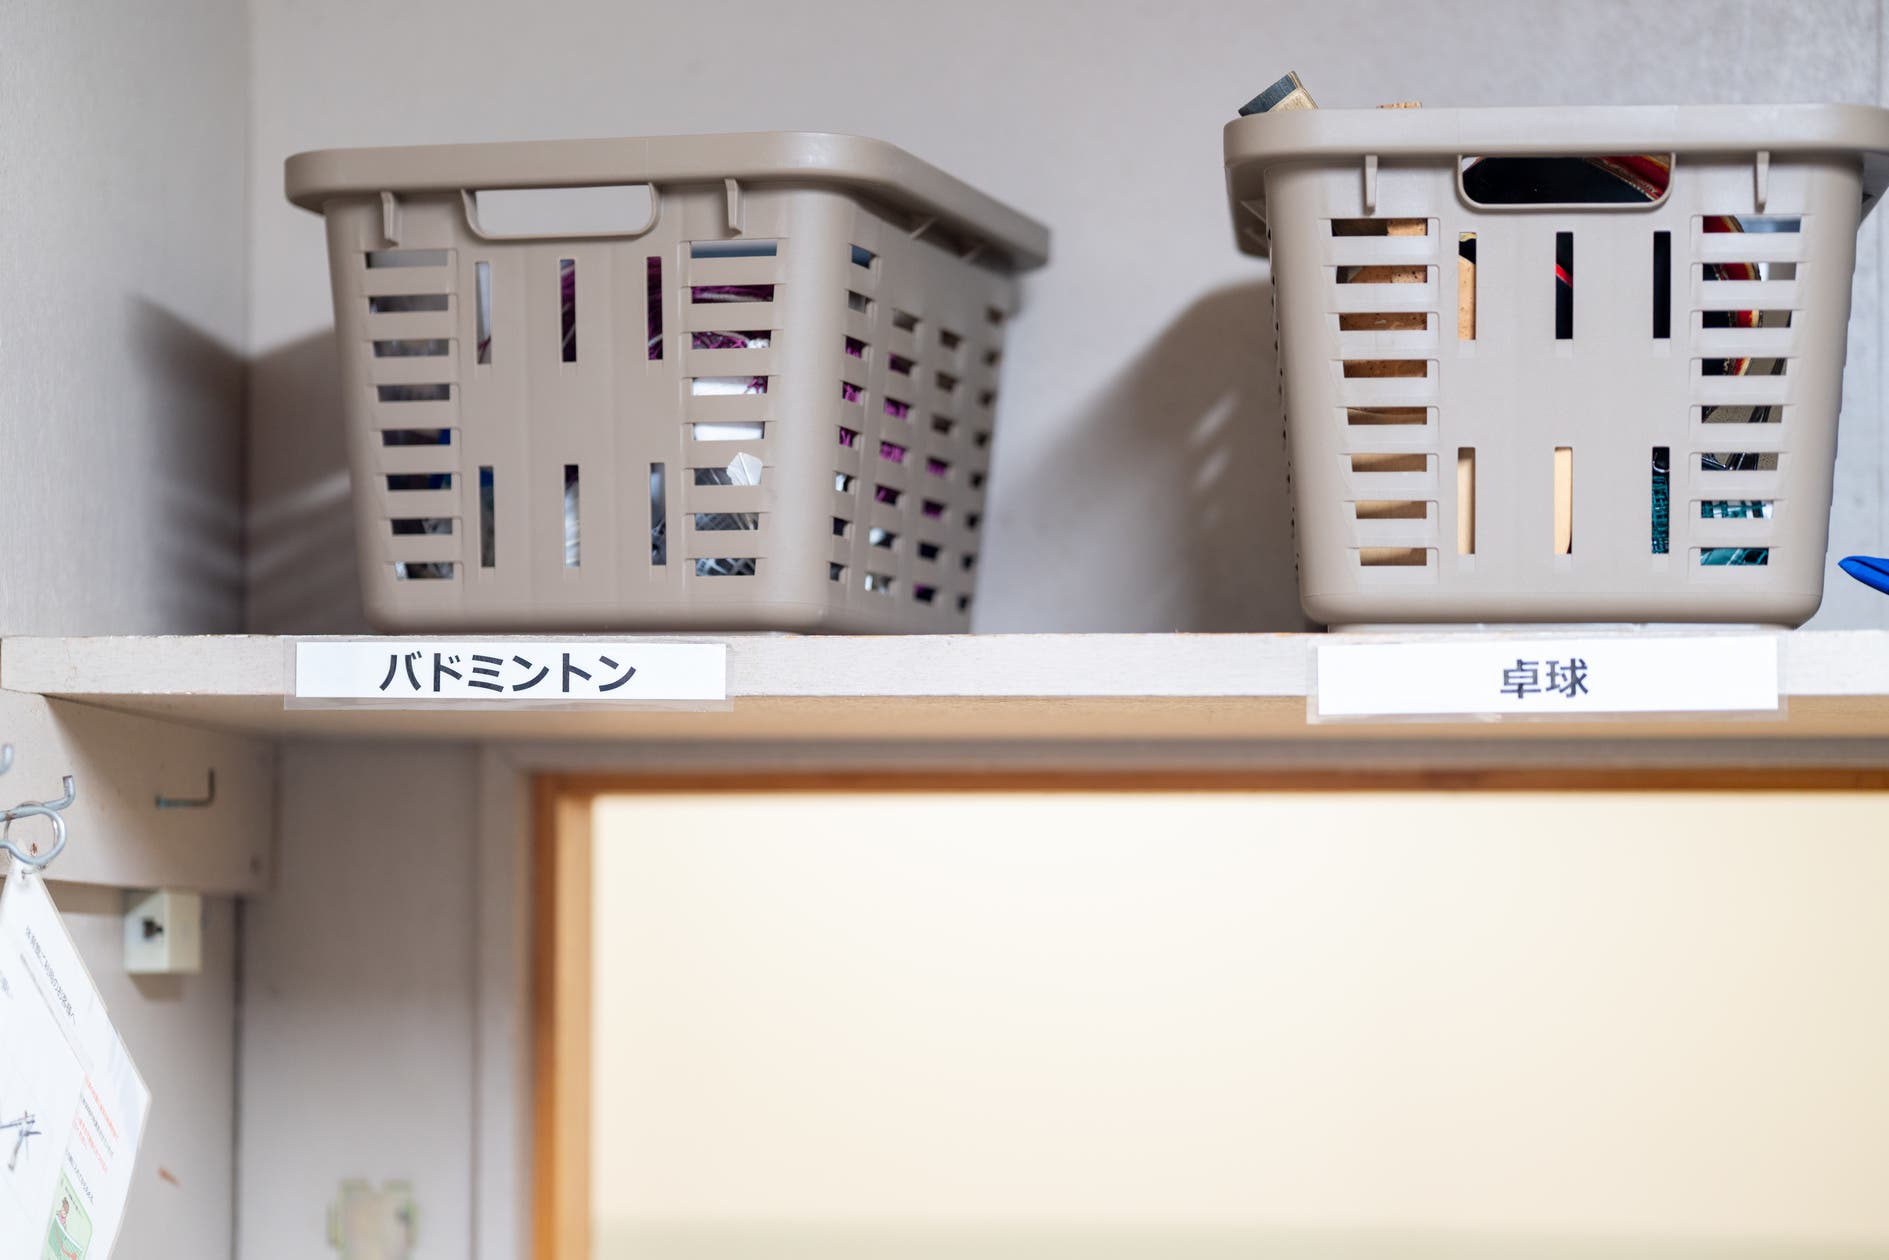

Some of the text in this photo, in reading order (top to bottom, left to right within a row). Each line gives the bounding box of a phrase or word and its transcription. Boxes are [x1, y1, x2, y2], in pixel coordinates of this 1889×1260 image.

[379, 651, 637, 692] バドミントン
[1500, 658, 1589, 699] 卓球
